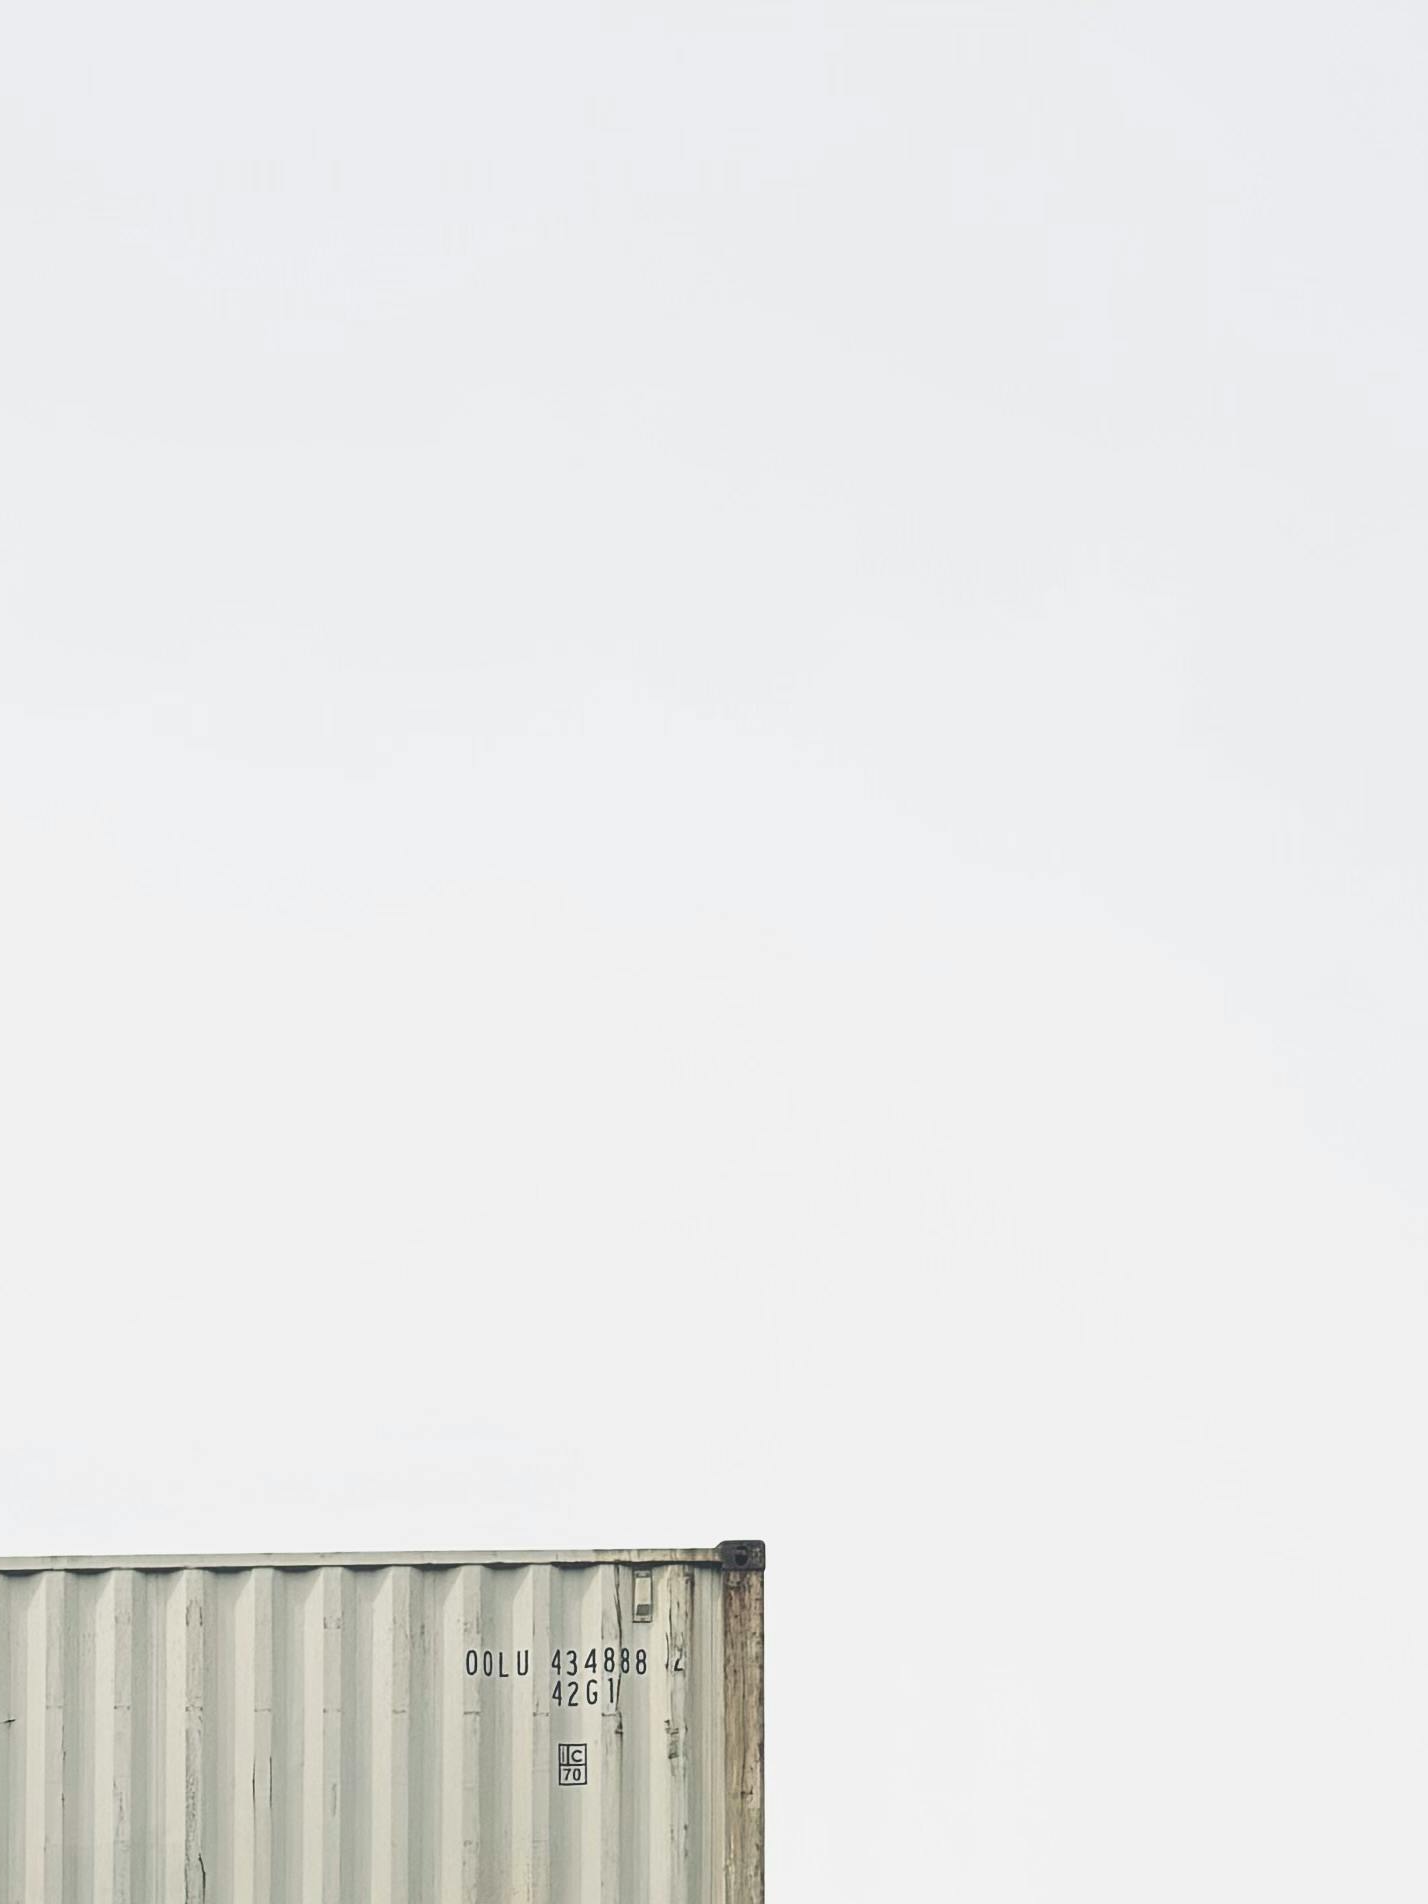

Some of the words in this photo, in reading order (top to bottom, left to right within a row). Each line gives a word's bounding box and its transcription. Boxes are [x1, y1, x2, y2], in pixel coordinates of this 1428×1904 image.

[551, 1647, 647, 1677] 434888
[551, 1678, 615, 1707] 42G1
[562, 1768, 582, 1782] 70
